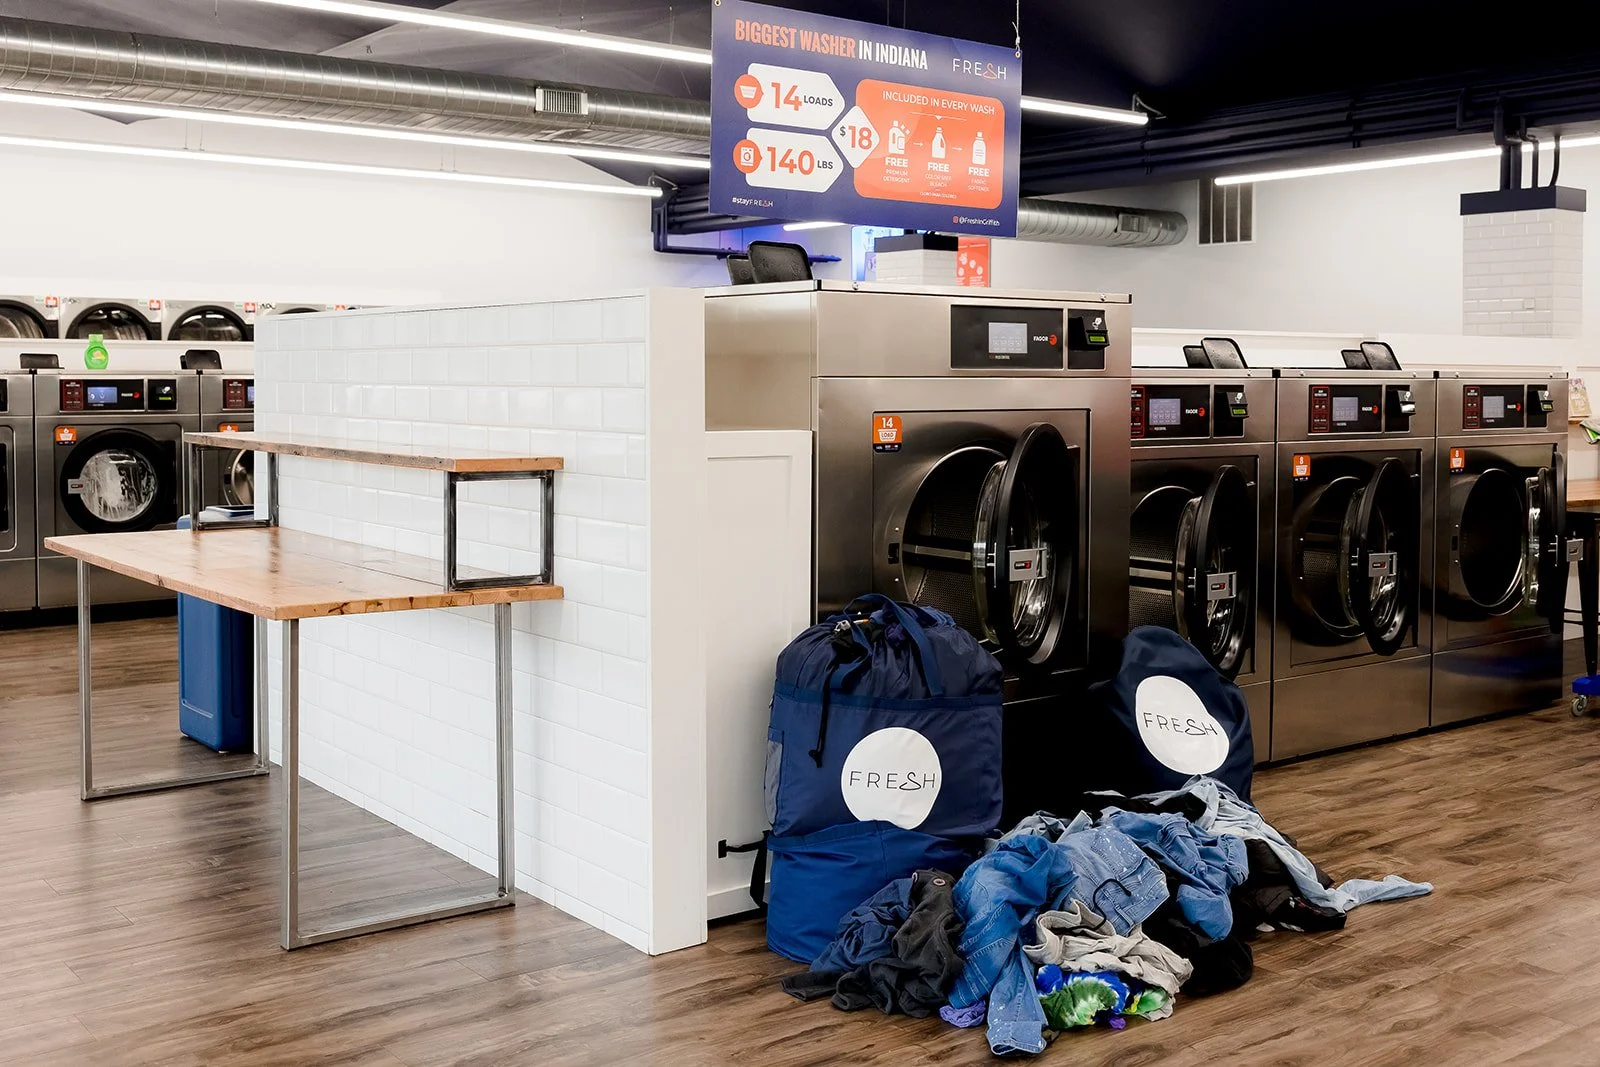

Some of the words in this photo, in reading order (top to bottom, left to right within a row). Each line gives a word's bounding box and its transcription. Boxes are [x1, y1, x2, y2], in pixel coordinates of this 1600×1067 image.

[735, 19, 797, 49] BIGGEST
[800, 30, 856, 58] WASHER
[858, 39, 873, 61] IN
[875, 43, 928, 70] INDIANA
[952, 58, 1007, 80] FRESH
[771, 82, 802, 111] 14
[803, 95, 833, 107] LOADS
[882, 90, 929, 106] INCLUDED
[930, 97, 940, 107] IN
[941, 99, 968, 111] EVERY
[970, 103, 995, 115] WASH
[767, 146, 814, 175] 140
[817, 160, 833, 170] LBS
[885, 156, 908, 168] FREE
[927, 161, 950, 173] FREE
[883, 175, 911, 183] DETERGENT
[968, 166, 990, 177] FREE
[882, 417, 894, 428] 14
[1143, 712, 1218, 735] FRESH
[850, 770, 936, 791] FRESH
